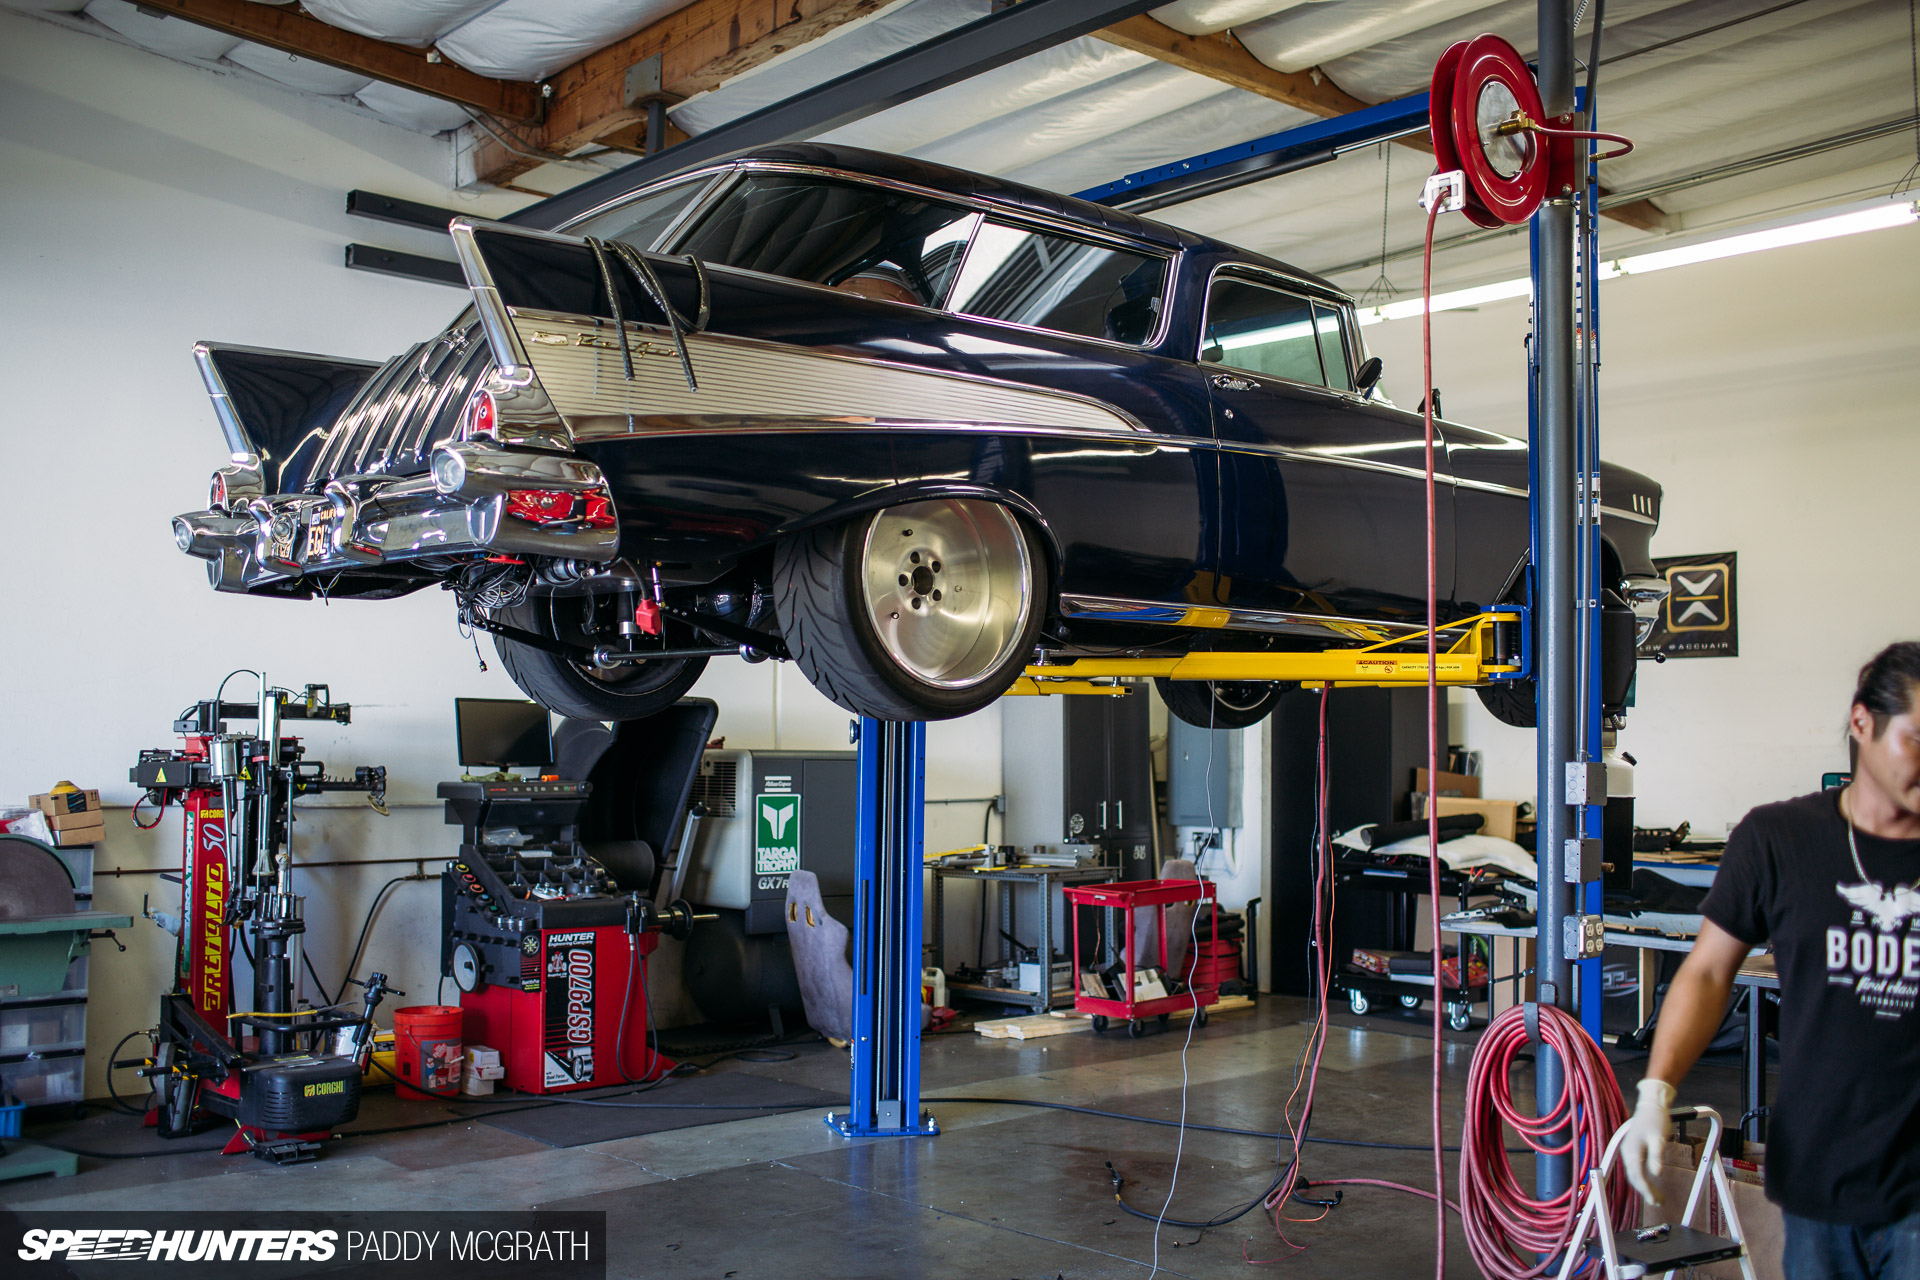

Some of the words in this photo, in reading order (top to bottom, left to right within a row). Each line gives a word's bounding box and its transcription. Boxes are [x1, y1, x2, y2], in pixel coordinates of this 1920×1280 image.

[209, 809, 225, 819] CORG
[203, 823, 227, 859] 50
[758, 847, 797, 861] TARGA
[758, 860, 798, 872] TROPHY
[549, 932, 595, 943] HUNTER
[567, 948, 593, 1044] GSP9700
[316, 1080, 344, 1096] CORGHI
